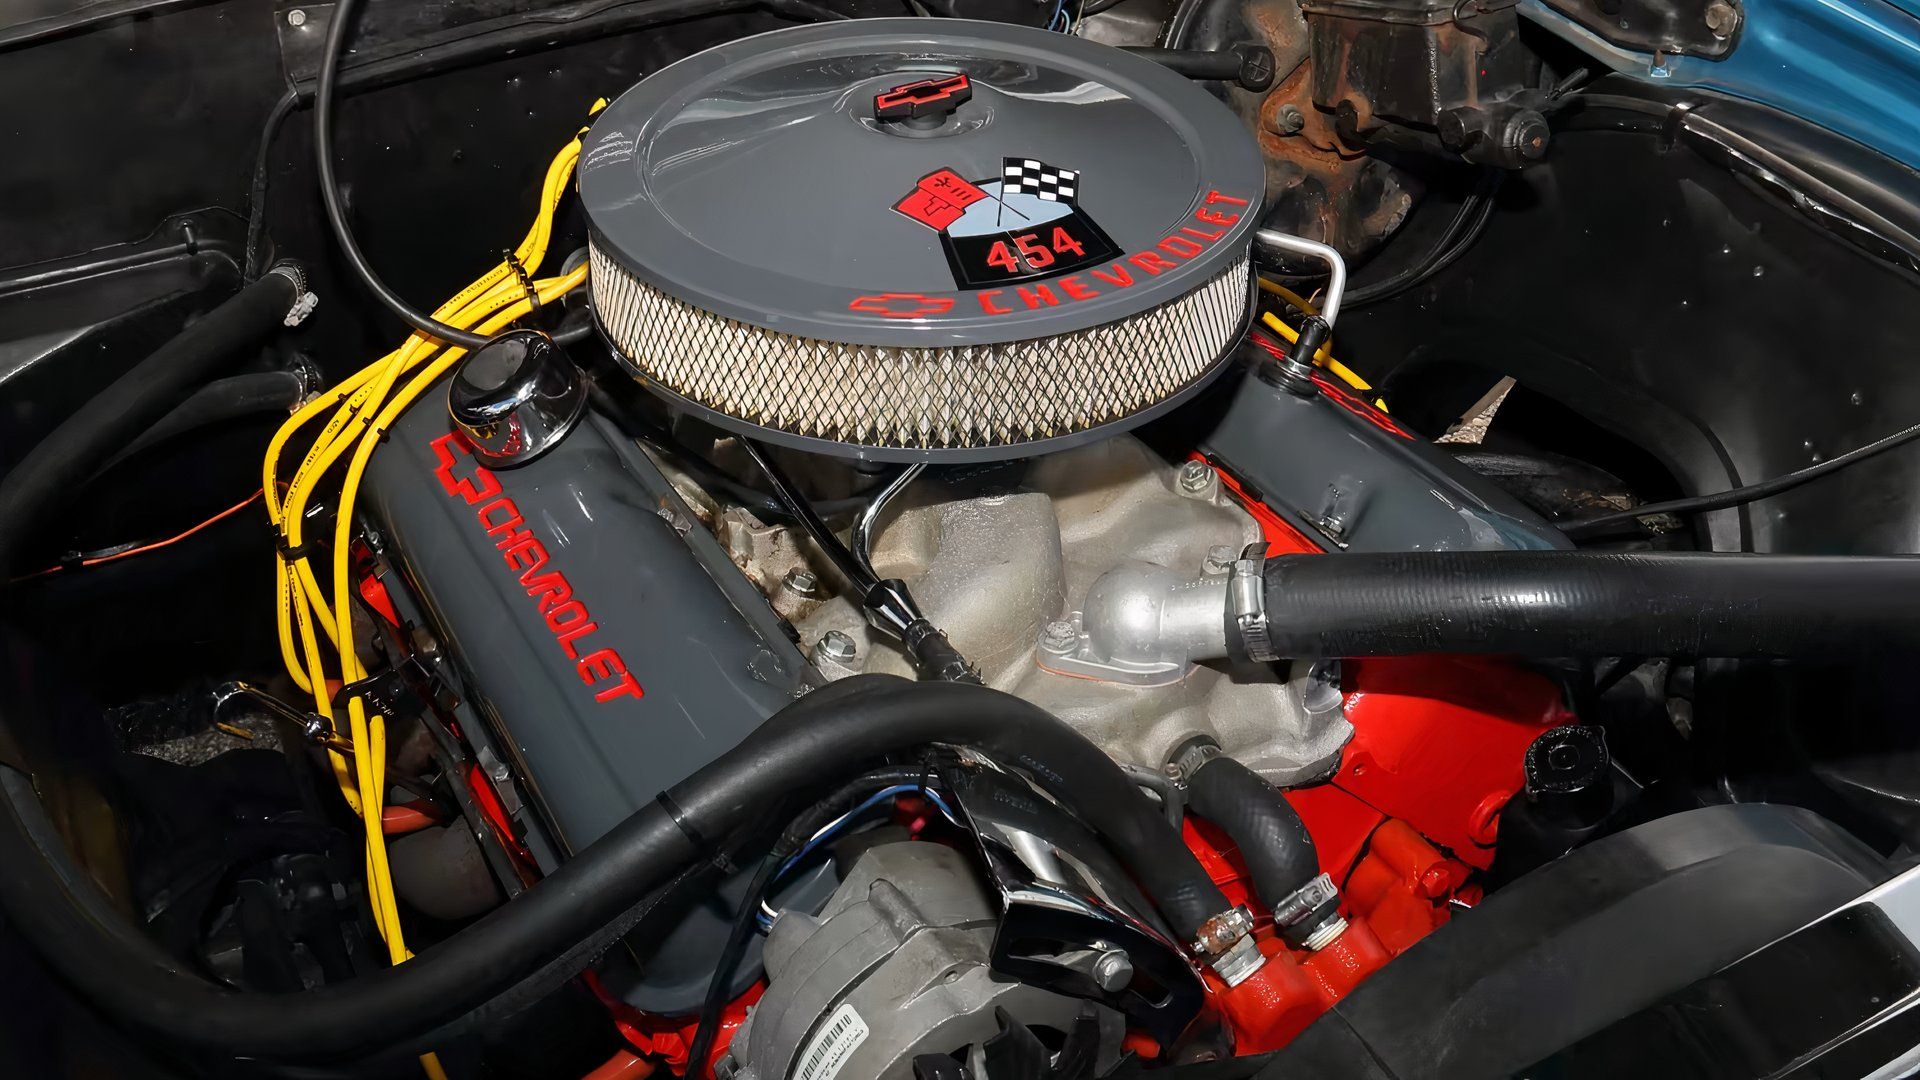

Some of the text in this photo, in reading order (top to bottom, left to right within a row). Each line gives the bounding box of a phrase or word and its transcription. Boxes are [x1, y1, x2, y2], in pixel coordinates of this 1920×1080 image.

[978, 189, 1249, 316] CHEVROLET
[986, 226, 1085, 273] 454
[478, 497, 644, 703] CHEVROLET
